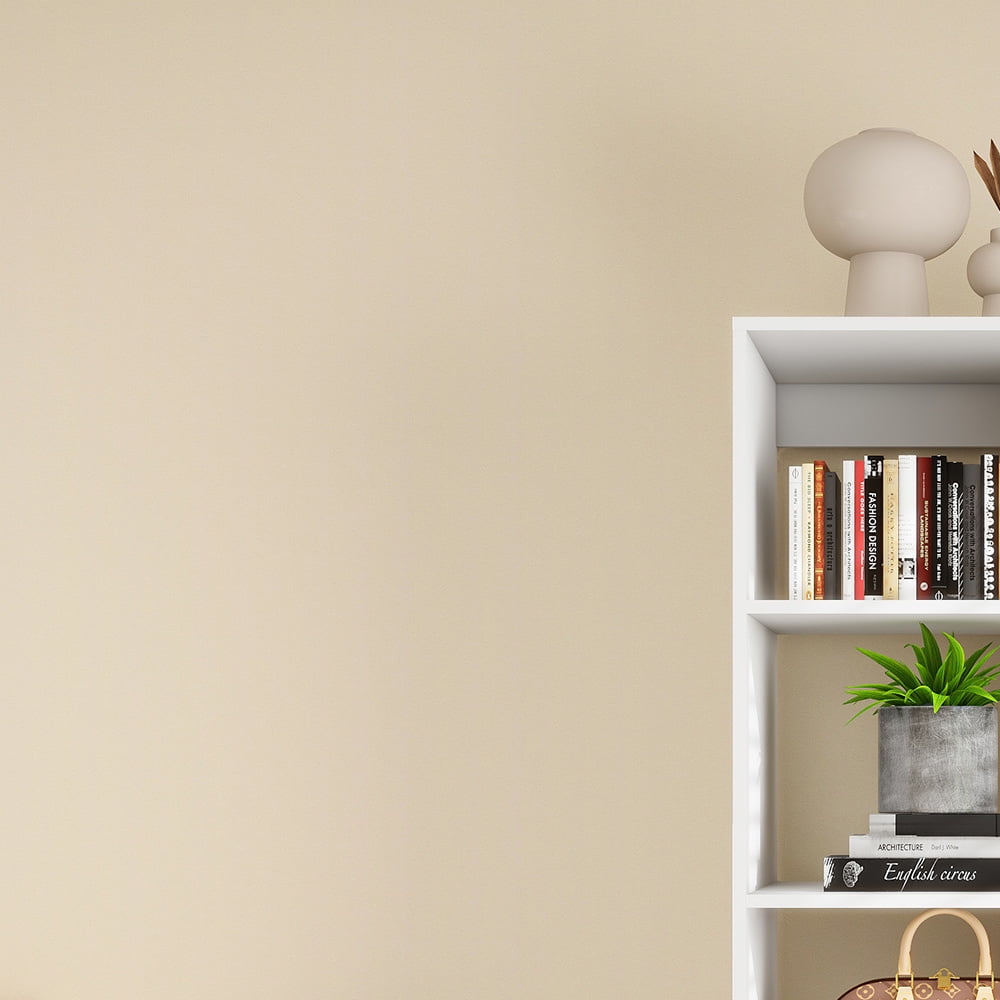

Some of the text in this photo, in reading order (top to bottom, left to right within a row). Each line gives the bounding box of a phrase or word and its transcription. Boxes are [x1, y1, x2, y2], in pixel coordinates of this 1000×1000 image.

[868, 492, 877, 532] FASHION
[868, 535, 877, 570] DESIGN
[878, 843, 924, 851] ARCHITECTURE
[883, 857, 976, 892] English circus
